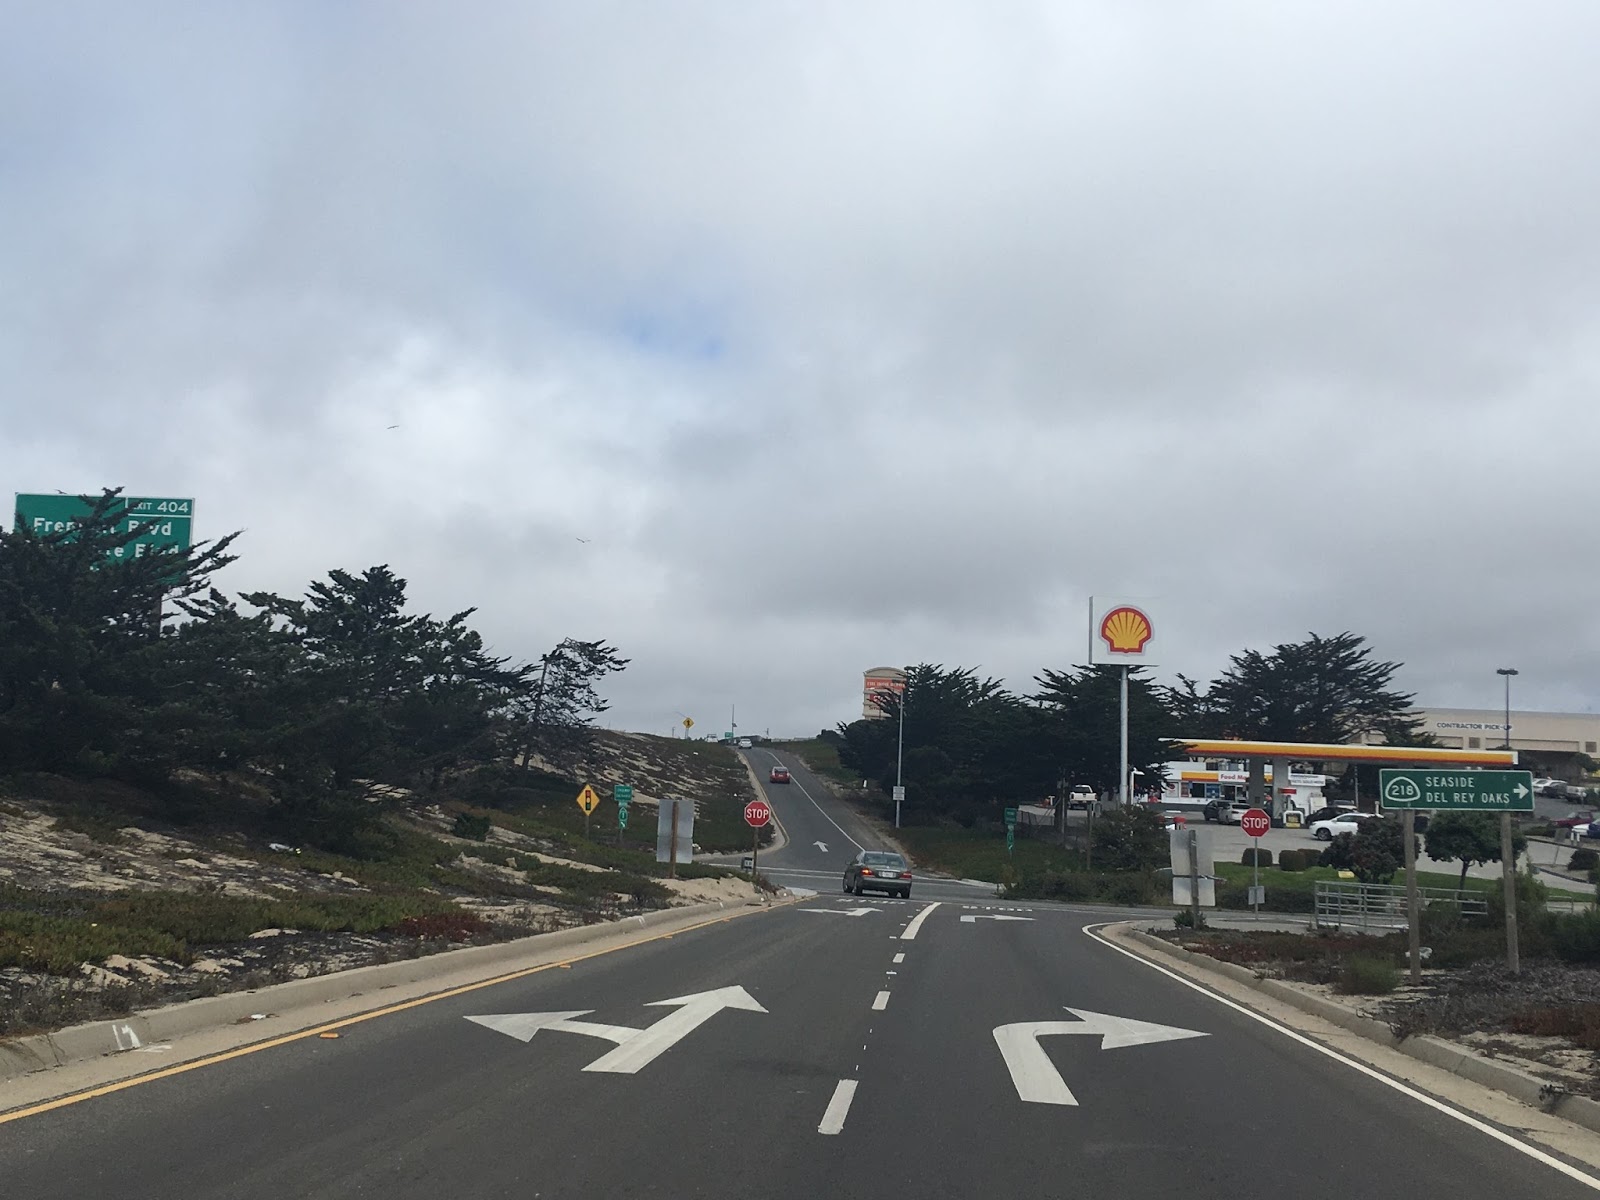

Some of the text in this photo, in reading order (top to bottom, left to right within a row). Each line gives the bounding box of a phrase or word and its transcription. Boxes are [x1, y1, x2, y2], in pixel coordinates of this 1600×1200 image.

[133, 501, 189, 512] XIT 404
[1437, 722, 1483, 730] CONTRACTOR
[1425, 776, 1475, 788] SEASIDE
[1391, 785, 1414, 796] 218
[1426, 792, 1510, 804] DEL REY OAKS
[746, 808, 769, 819] STOP
[1243, 817, 1268, 829] STOP
